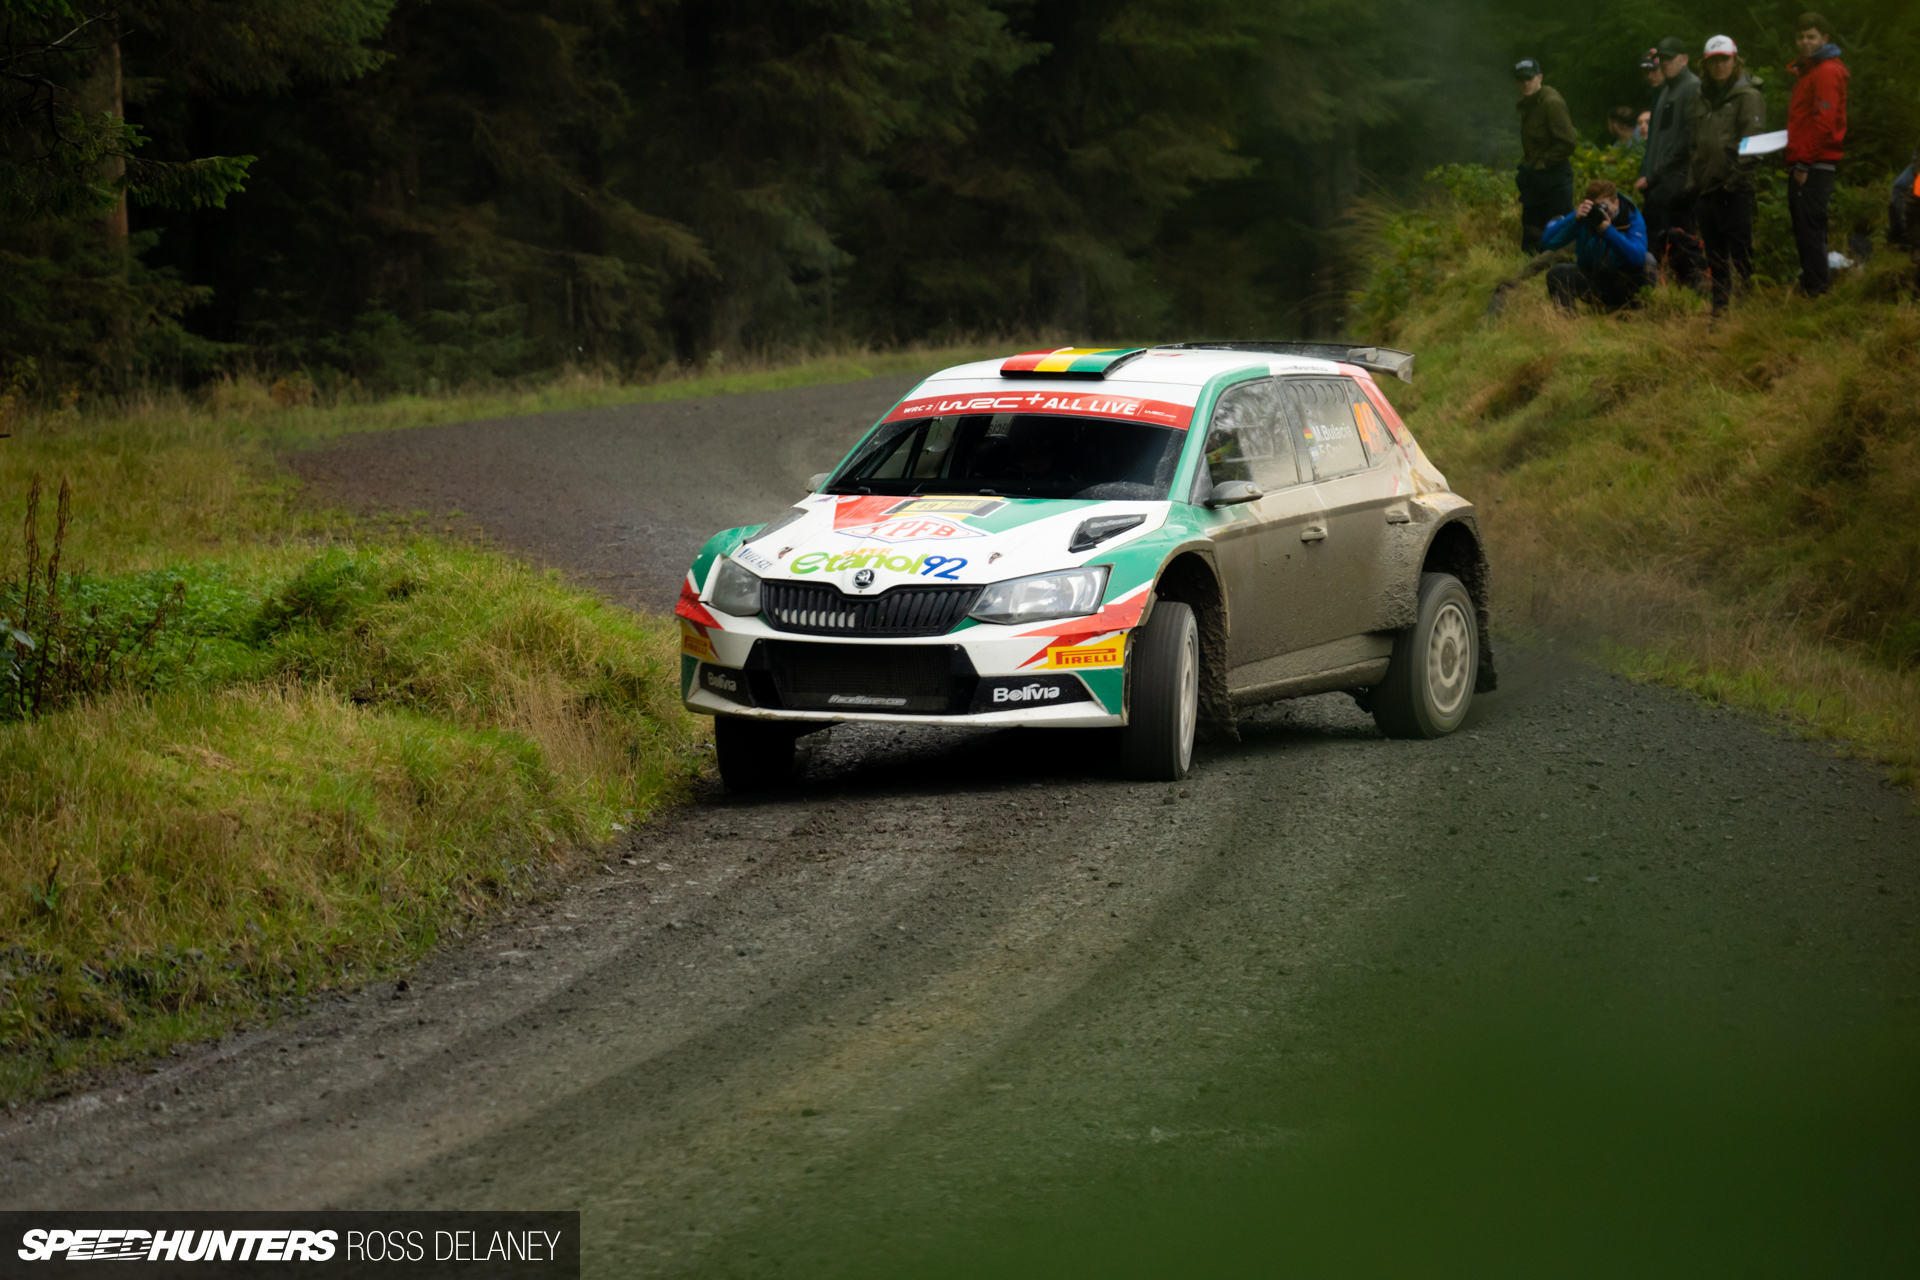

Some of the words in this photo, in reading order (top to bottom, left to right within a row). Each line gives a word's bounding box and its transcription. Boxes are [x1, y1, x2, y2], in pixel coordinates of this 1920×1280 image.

[903, 405, 925, 414] WRC
[1041, 397, 1083, 410] ALL
[1089, 400, 1139, 415] LIVE
[1055, 647, 1117, 665] PIRELLI
[993, 683, 1060, 703] Bolivia
